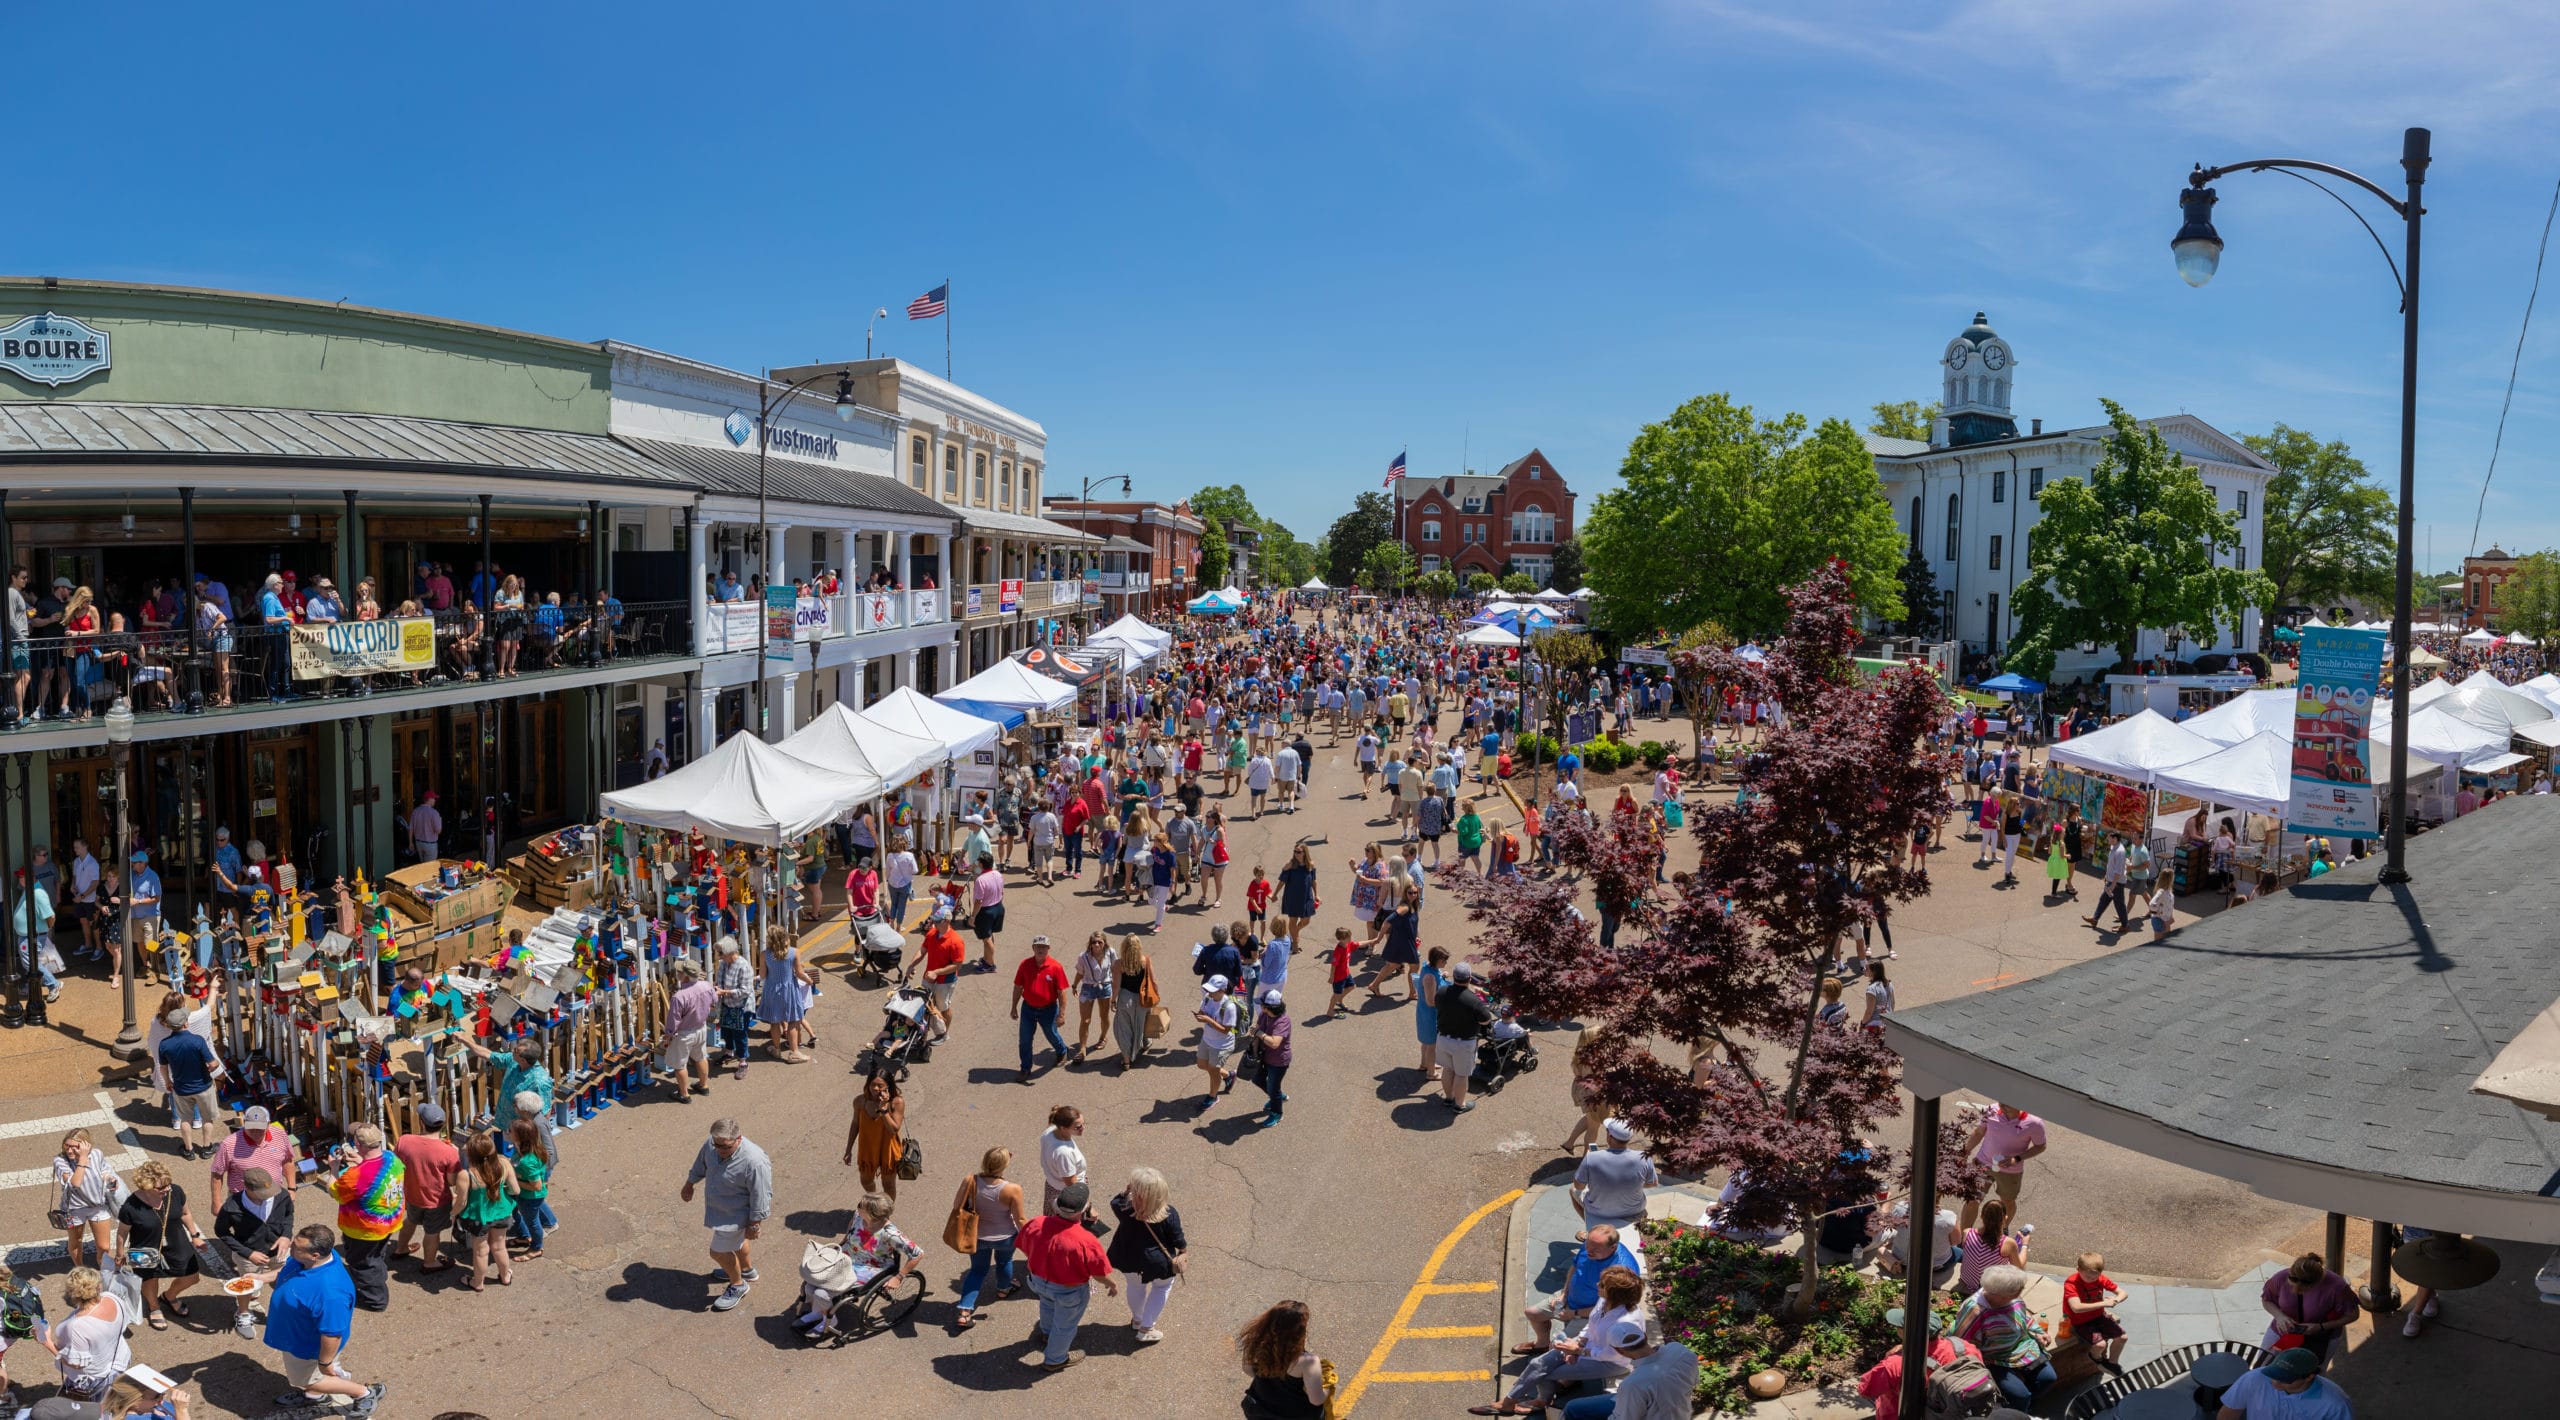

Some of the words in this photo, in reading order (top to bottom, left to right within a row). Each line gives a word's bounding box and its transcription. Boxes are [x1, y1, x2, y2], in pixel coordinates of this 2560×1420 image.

[30, 328, 72, 336] OXFORD
[4, 336, 98, 359] BOURÉ
[755, 416, 839, 457] Trustmark
[946, 414, 960, 431] THE
[963, 420, 997, 444] THOMPSON
[998, 433, 1017, 452] HOUSE
[1006, 581, 1017, 590] TATE
[292, 631, 325, 644] 2019
[328, 620, 399, 655] OXFORD
[332, 654, 368, 662] BOURBON
[369, 651, 397, 660] FESTIVAL
[343, 660, 360, 668] AND
[2313, 659, 2342, 668] Double
[2343, 660, 2374, 670] Decker
[2306, 802, 2344, 812] WINCHESTER
